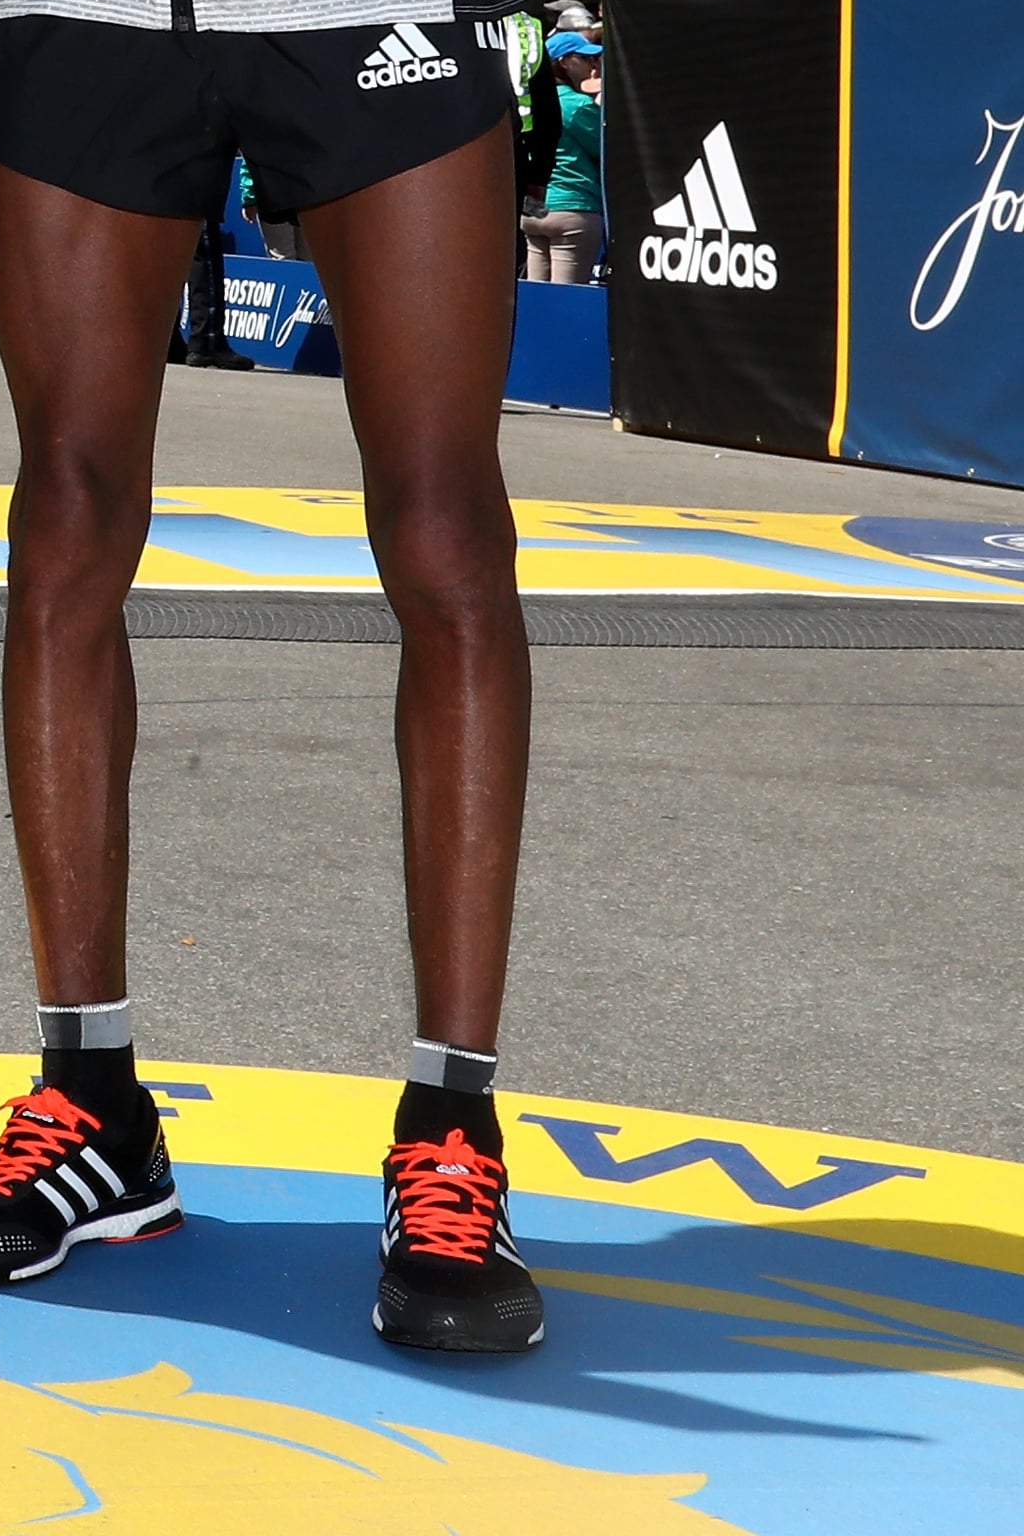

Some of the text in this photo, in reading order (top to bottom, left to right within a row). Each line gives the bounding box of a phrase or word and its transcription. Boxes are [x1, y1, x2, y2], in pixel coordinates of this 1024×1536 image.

[356, 57, 459, 90] adidas
[639, 226, 777, 291] adidas
[223, 308, 269, 341] ATHON
